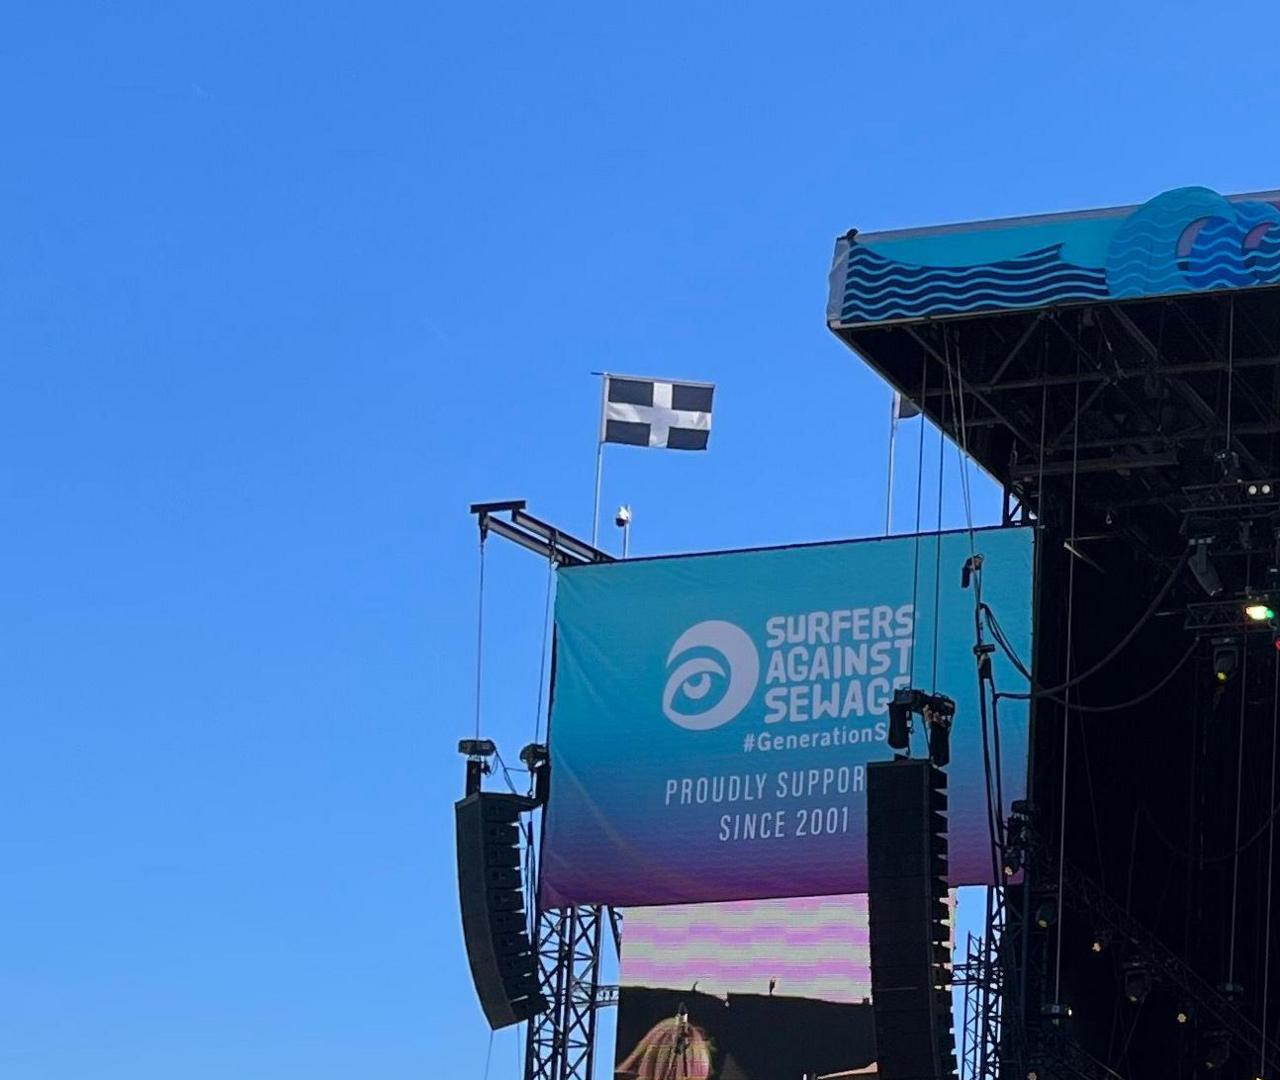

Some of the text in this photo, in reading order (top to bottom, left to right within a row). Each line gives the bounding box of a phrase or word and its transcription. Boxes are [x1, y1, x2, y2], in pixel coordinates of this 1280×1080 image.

[765, 604, 914, 649] SURFERS
[765, 638, 912, 685] AGAINST
[665, 774, 767, 806] PROUDLY
[719, 805, 849, 842] SINCE 2001
